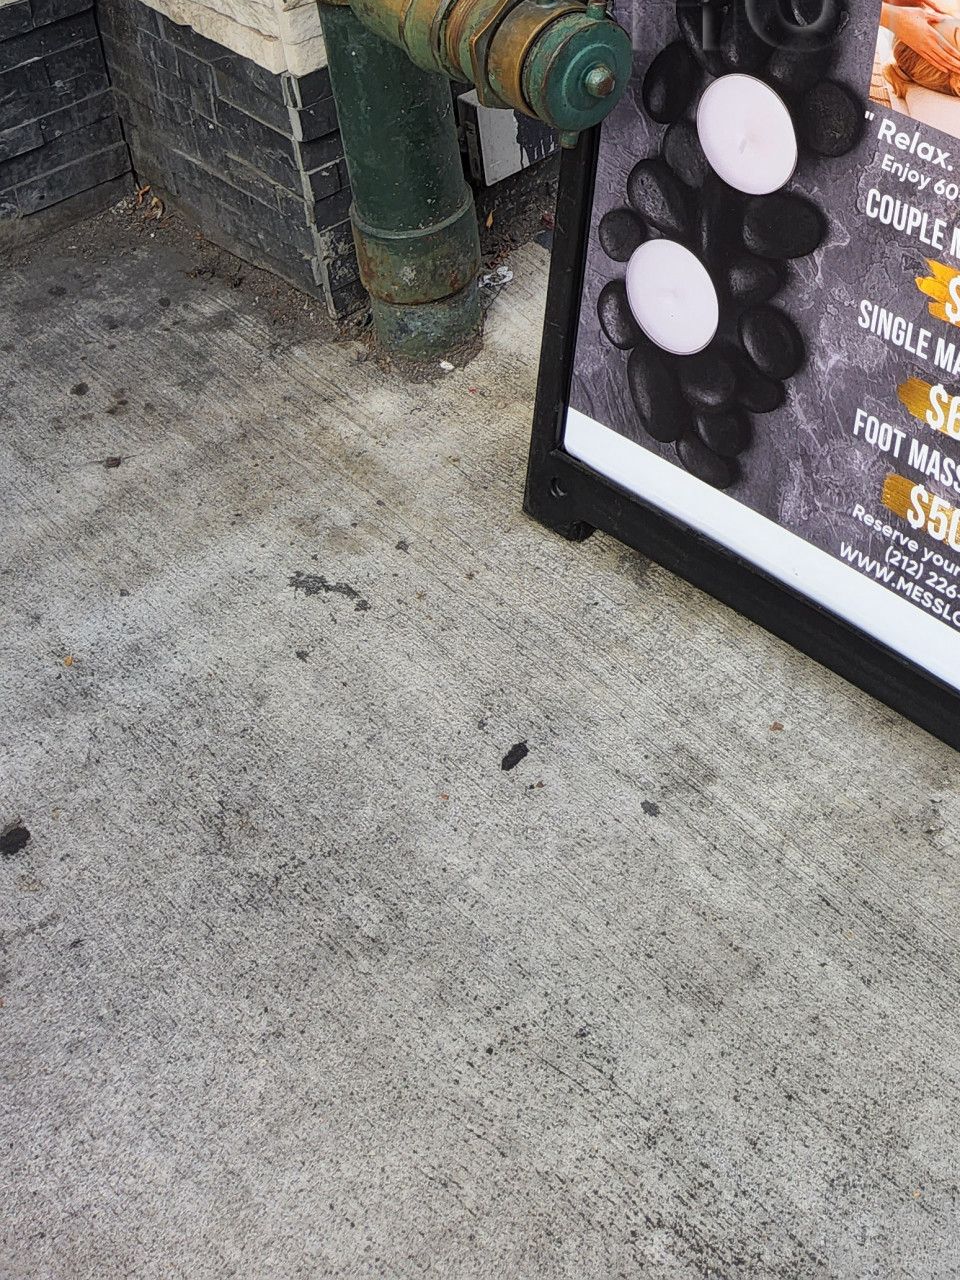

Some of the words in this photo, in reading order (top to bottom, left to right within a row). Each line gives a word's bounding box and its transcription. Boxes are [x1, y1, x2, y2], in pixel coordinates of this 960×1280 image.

[877, 118, 954, 174] Relax.
[881, 156, 932, 197] Enjoy
[865, 189, 947, 252] COUPLE
[857, 300, 932, 361] SINGLE
[852, 407, 906, 459] FOOT
[852, 503, 919, 553] Reserve
[883, 543, 924, 582] (212)
